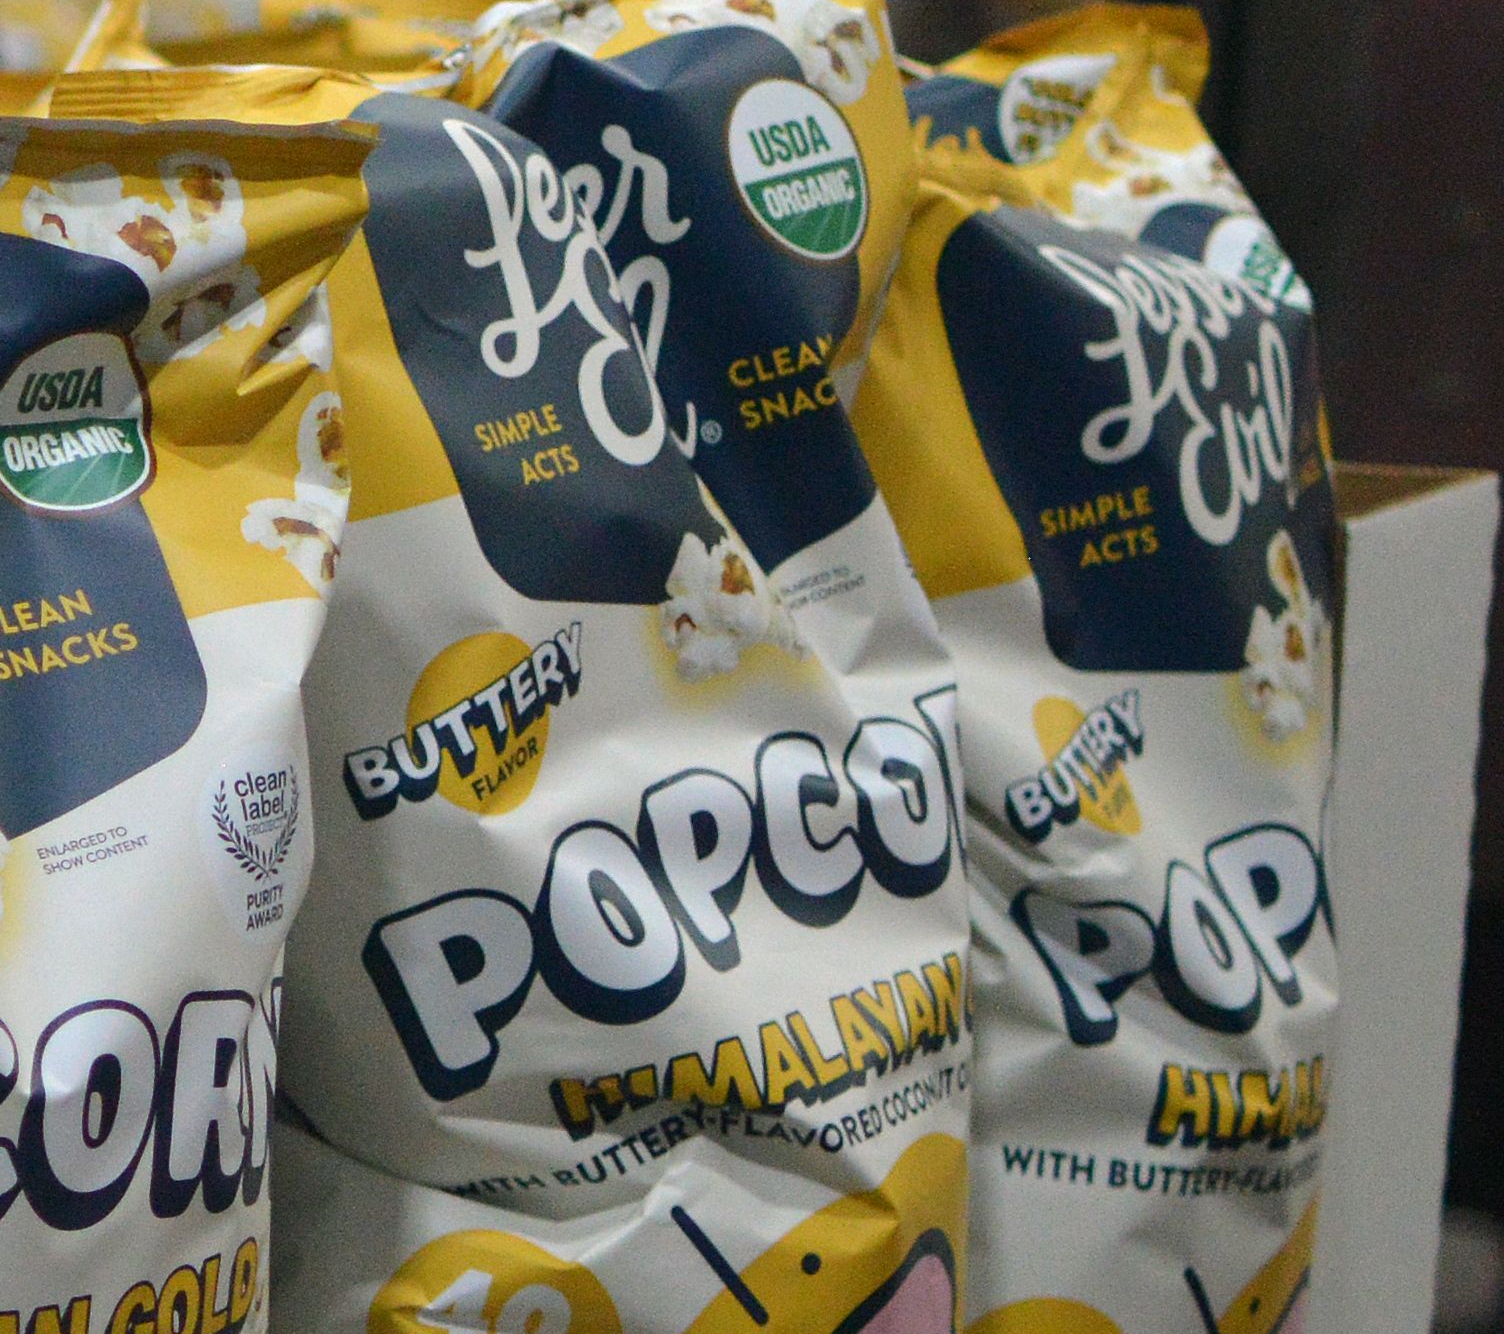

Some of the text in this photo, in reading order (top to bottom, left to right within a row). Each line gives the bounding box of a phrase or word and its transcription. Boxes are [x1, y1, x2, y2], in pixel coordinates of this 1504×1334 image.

[748, 113, 832, 168] USDA
[761, 167, 856, 219] ORGANIC
[15, 362, 106, 416] USDA
[2, 422, 136, 475] ORGANIC
[473, 403, 563, 455] SIMPLE
[520, 444, 581, 487] ACTS
[1039, 485, 1154, 538] SIMPLE
[1079, 524, 1160, 568] ACTS
[344, 620, 583, 821] BUTTERY
[234, 768, 288, 798] clean
[471, 734, 541, 802] FLAVOR
[1004, 687, 1147, 844] BUTTERY
[240, 789, 287, 823] label
[37, 825, 129, 861] ENLARGED TO
[42, 834, 150, 876] SHOW CONTENT
[245, 904, 284, 932] AWARD
[246, 884, 284, 911] PURITY
[360, 682, 967, 1104] POPCO
[1009, 821, 1337, 1047] POP
[1002, 1145, 1097, 1186] WITH
